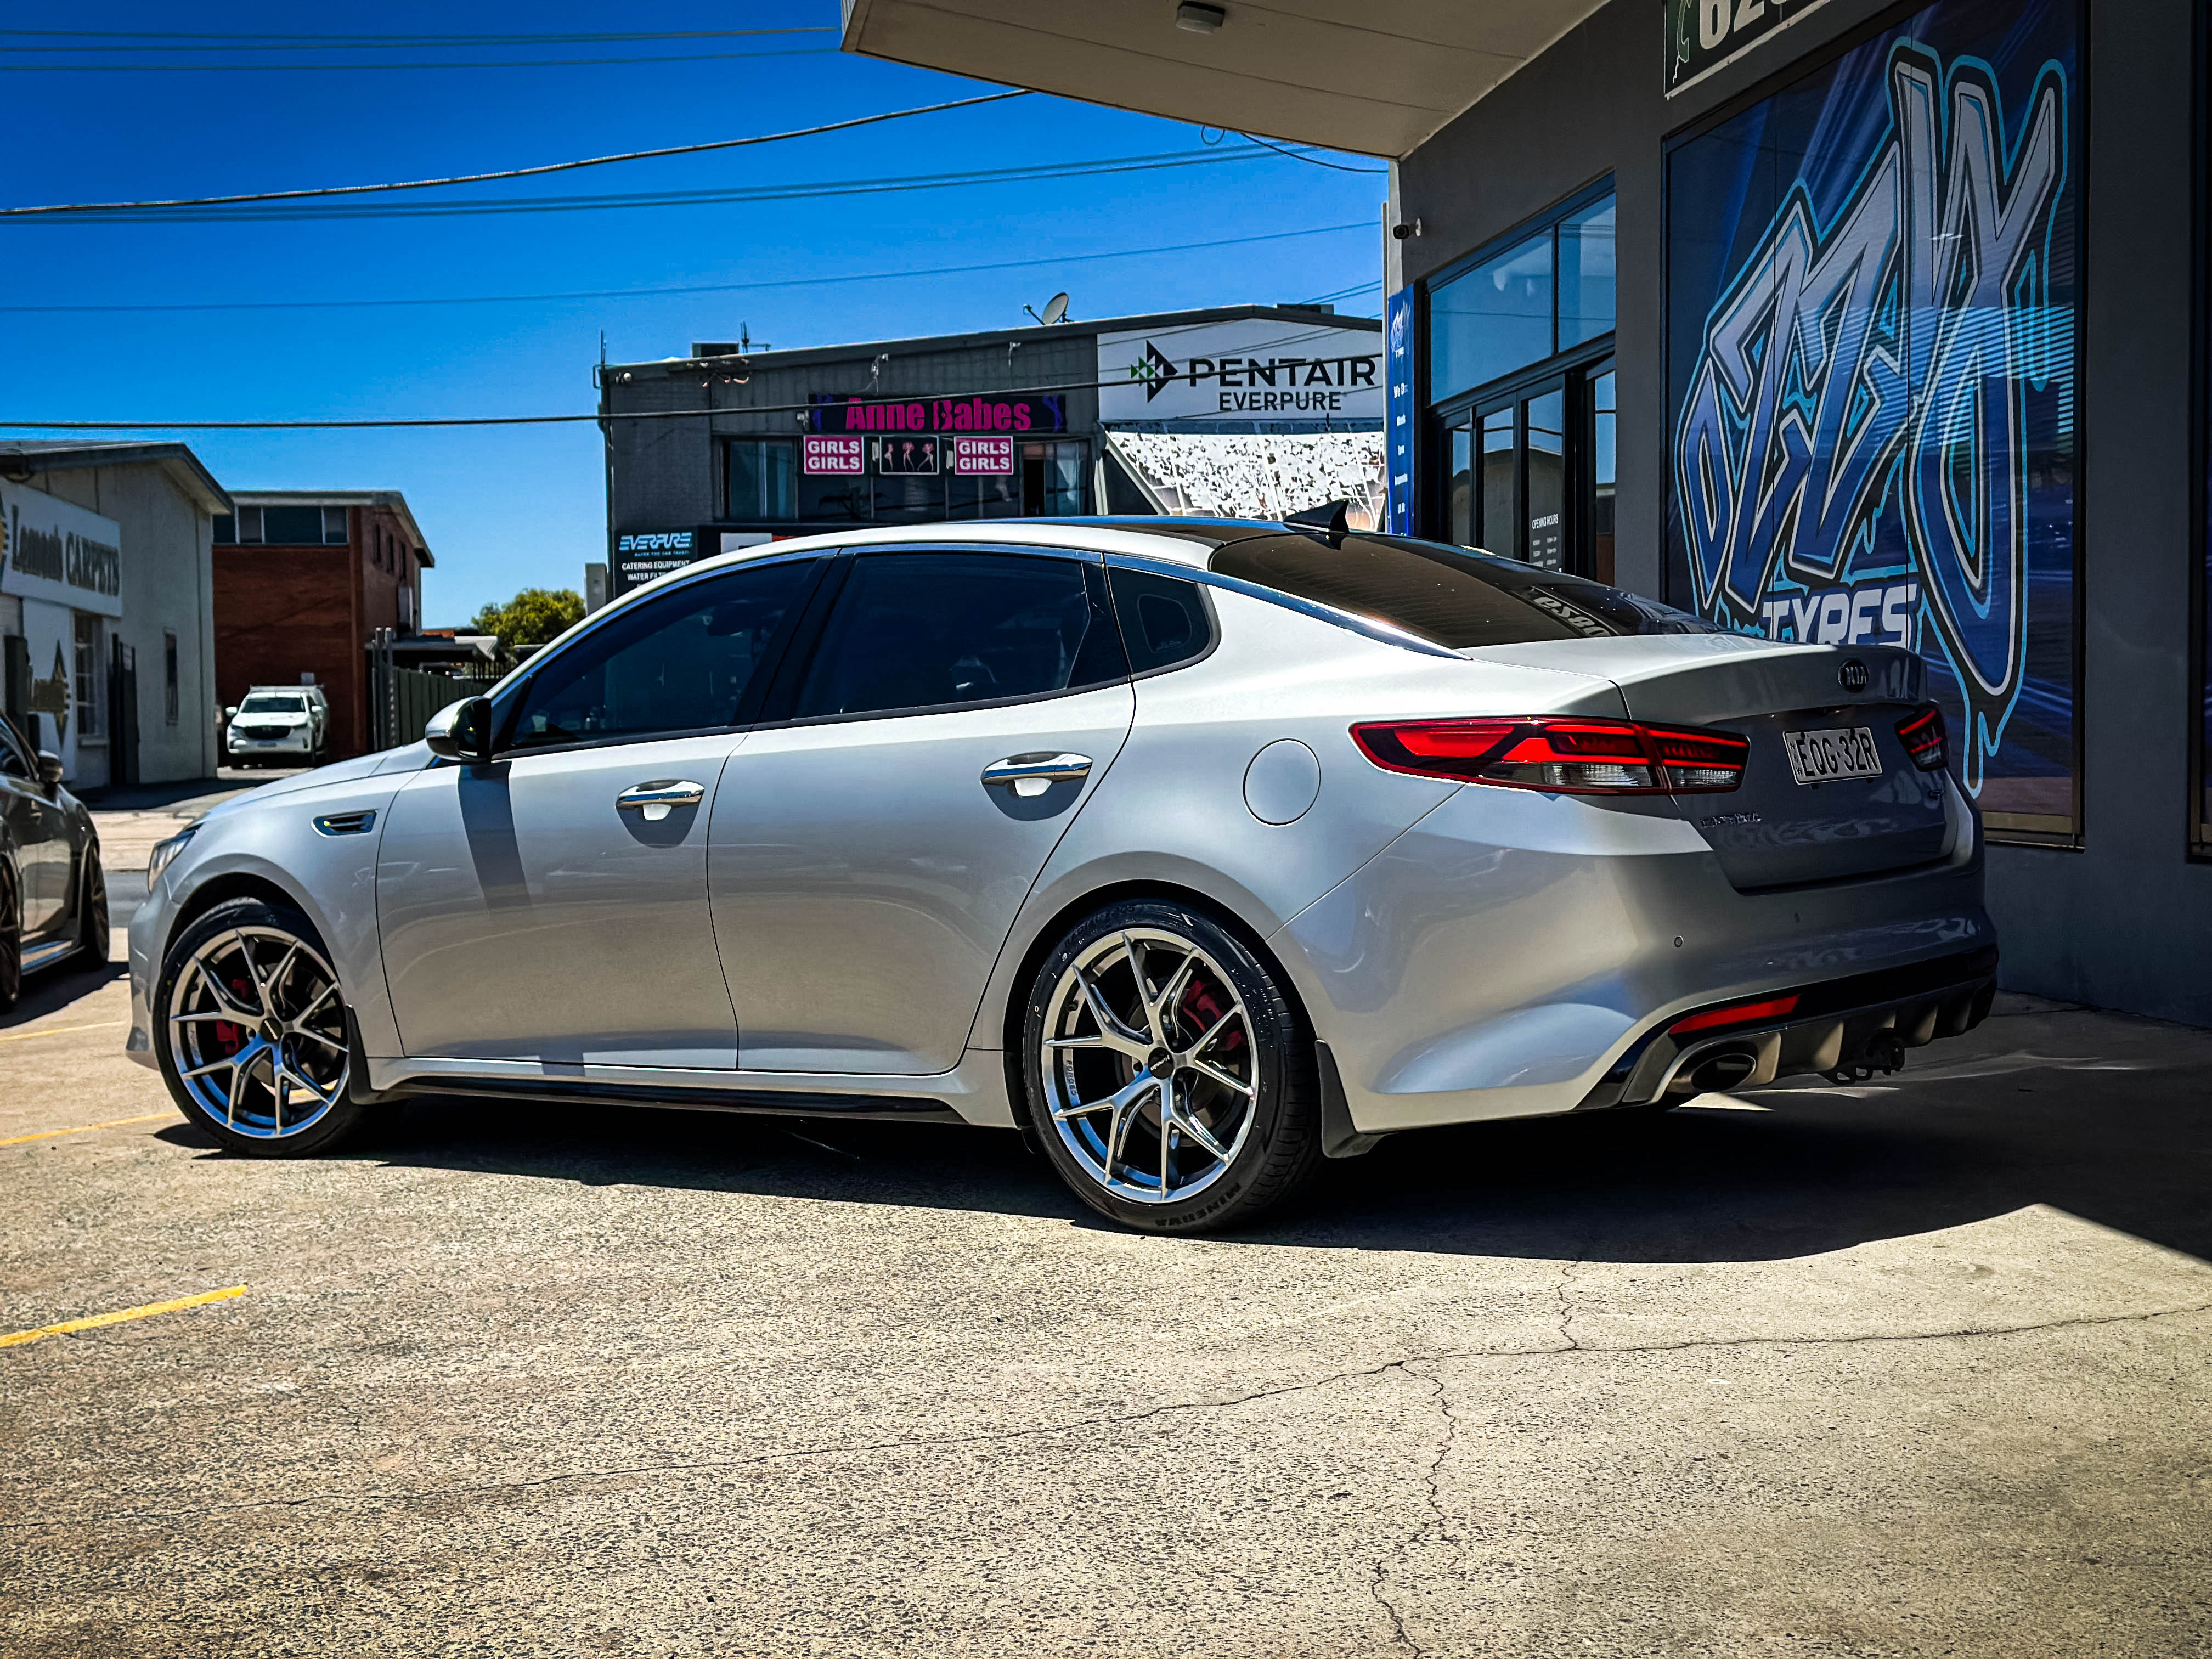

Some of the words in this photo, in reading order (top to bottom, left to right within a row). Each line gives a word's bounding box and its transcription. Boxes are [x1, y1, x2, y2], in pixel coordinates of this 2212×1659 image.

[1189, 358, 1376, 387] PENTAIR
[1219, 392, 1342, 411] EVERPURE
[845, 398, 926, 431] Anne
[933, 397, 1032, 431] Babes
[808, 441, 860, 455] GIRLS
[958, 441, 1010, 455] GIRLS
[808, 456, 860, 471] GIRLS
[959, 457, 1011, 471] GIRLS
[1532, 517, 1547, 529] OPENING
[1547, 514, 1559, 526] HOURS
[619, 532, 692, 551] EVERPURE
[622, 561, 653, 571] CATERING
[653, 560, 690, 569] EQUIPMENT
[627, 573, 649, 581] WATER
